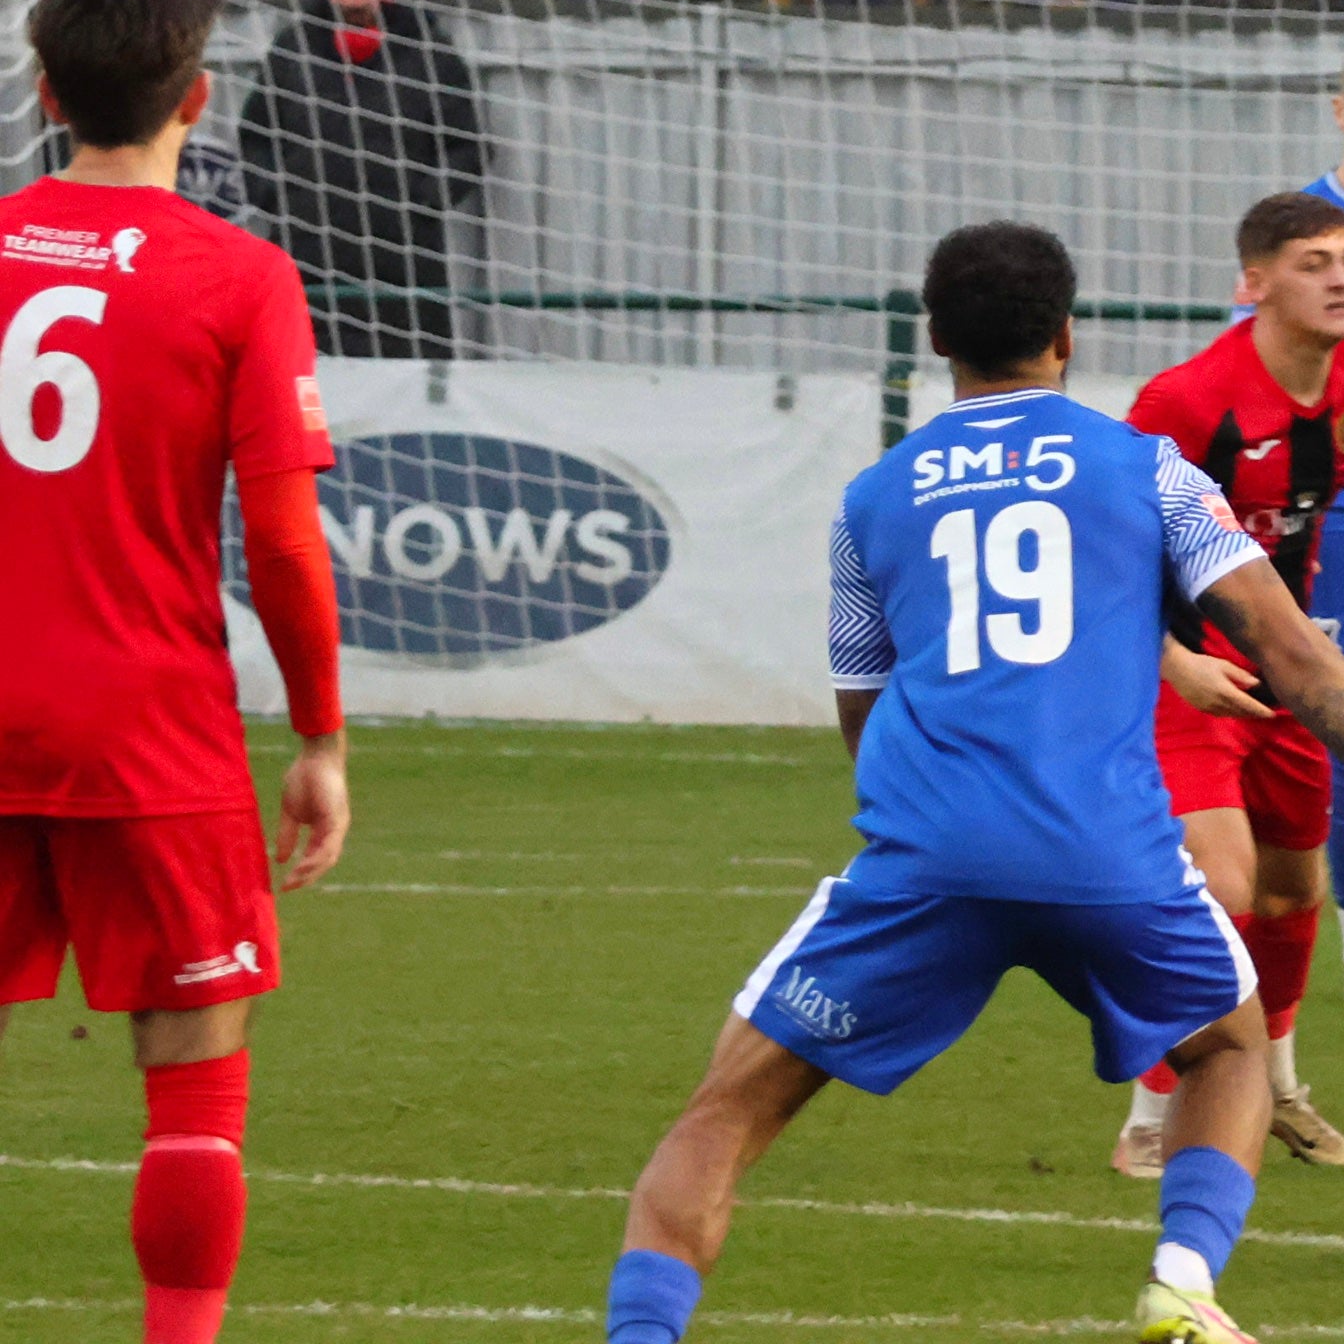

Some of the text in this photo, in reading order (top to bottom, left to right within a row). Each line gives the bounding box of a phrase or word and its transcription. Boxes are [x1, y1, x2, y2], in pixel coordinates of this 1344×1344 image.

[0, 285, 108, 472] 6
[320, 504, 633, 586] NOWS
[930, 500, 1074, 675] 19
